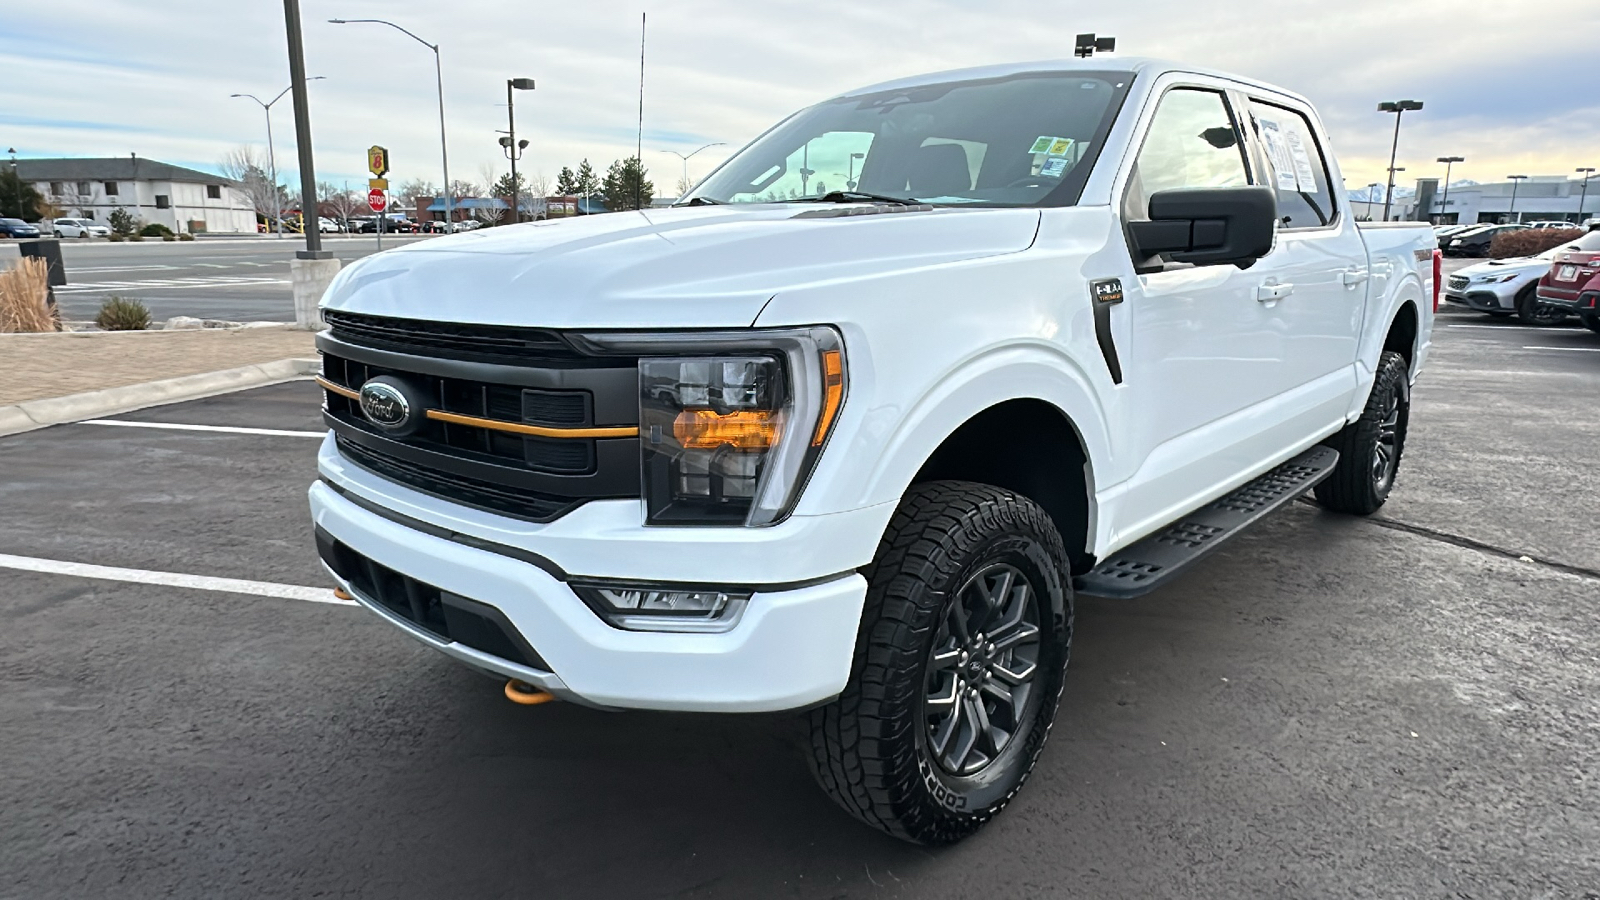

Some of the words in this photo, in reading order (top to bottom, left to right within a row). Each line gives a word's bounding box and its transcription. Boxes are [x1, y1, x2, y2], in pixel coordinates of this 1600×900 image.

[373, 155, 382, 169] 8
[370, 195, 386, 205] STOP
[366, 393, 394, 419] Ford
